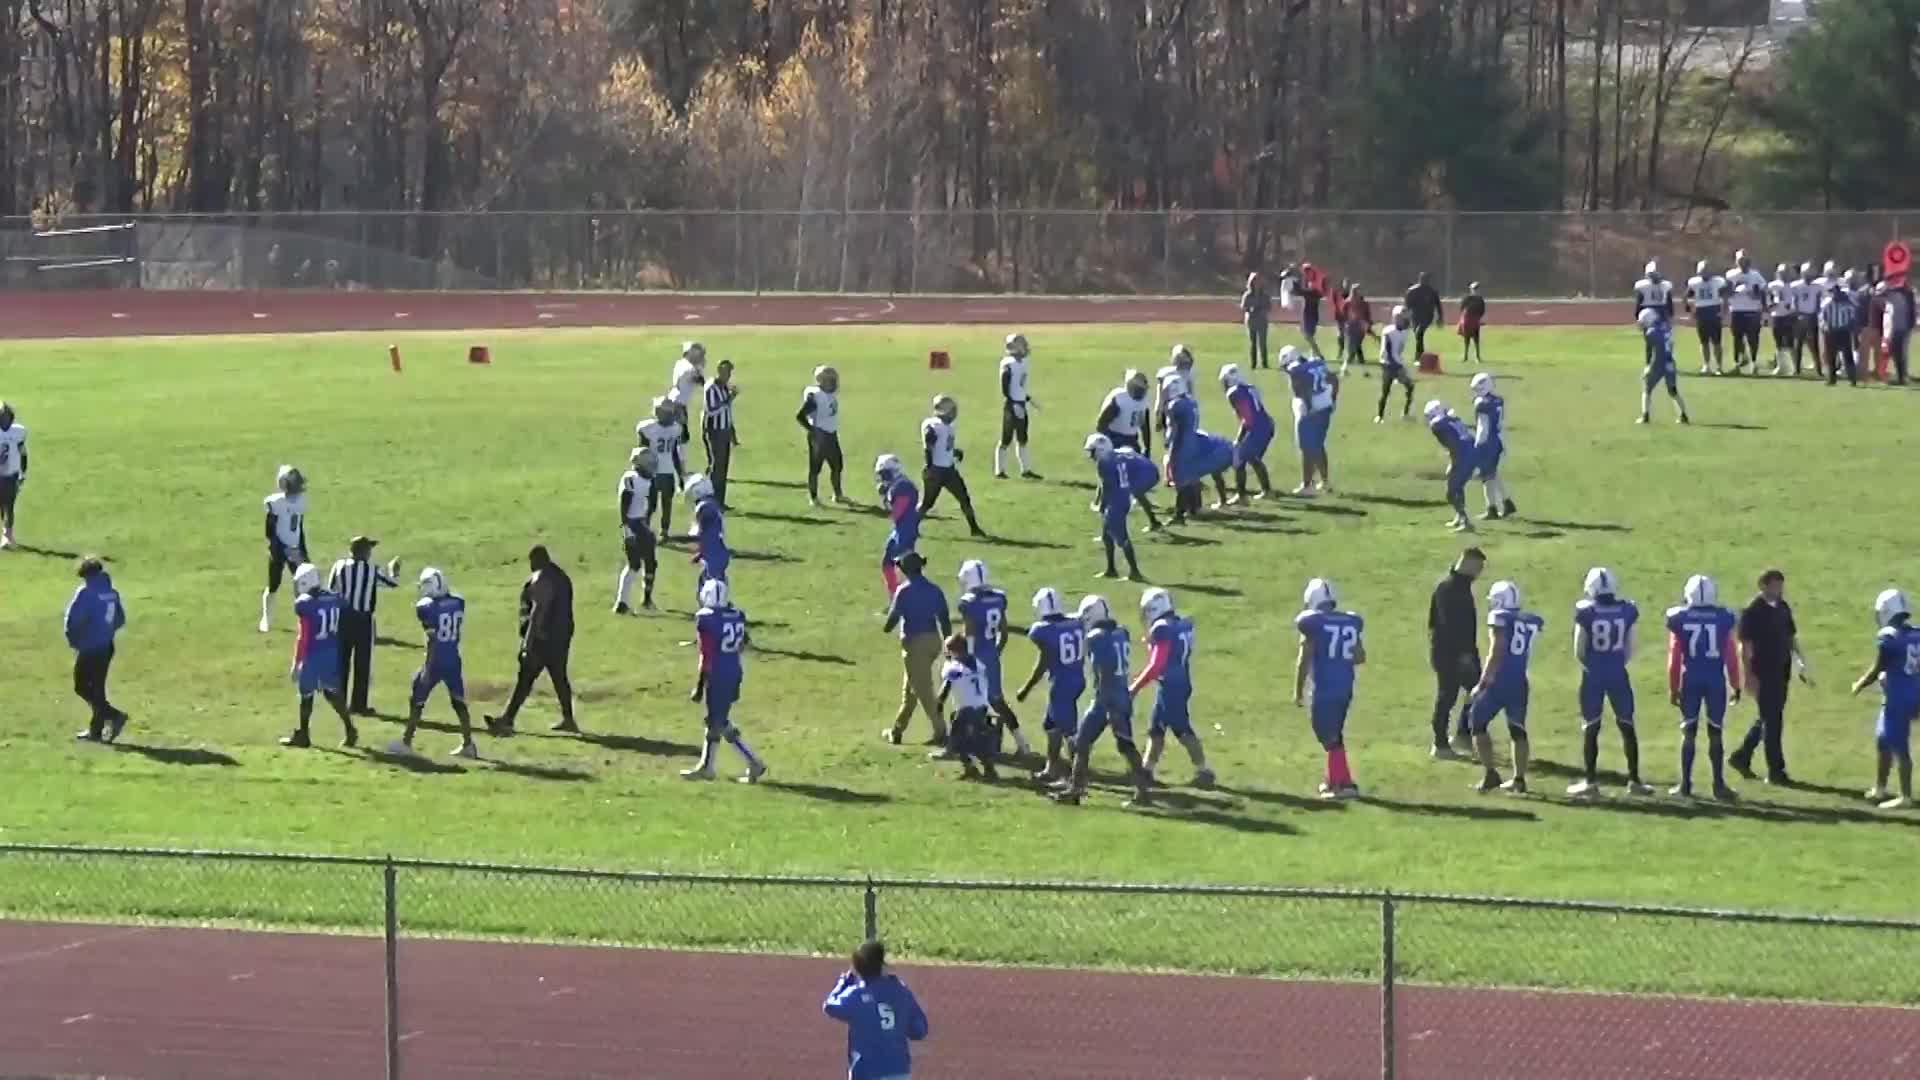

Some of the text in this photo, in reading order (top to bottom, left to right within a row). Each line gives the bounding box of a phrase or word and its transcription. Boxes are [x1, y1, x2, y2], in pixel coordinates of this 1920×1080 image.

[1323, 624, 1357, 659] 72
[1510, 620, 1538, 656] 67
[1591, 618, 1626, 652] 81
[1682, 623, 1720, 659] 71
[878, 1002, 896, 1030] 5
